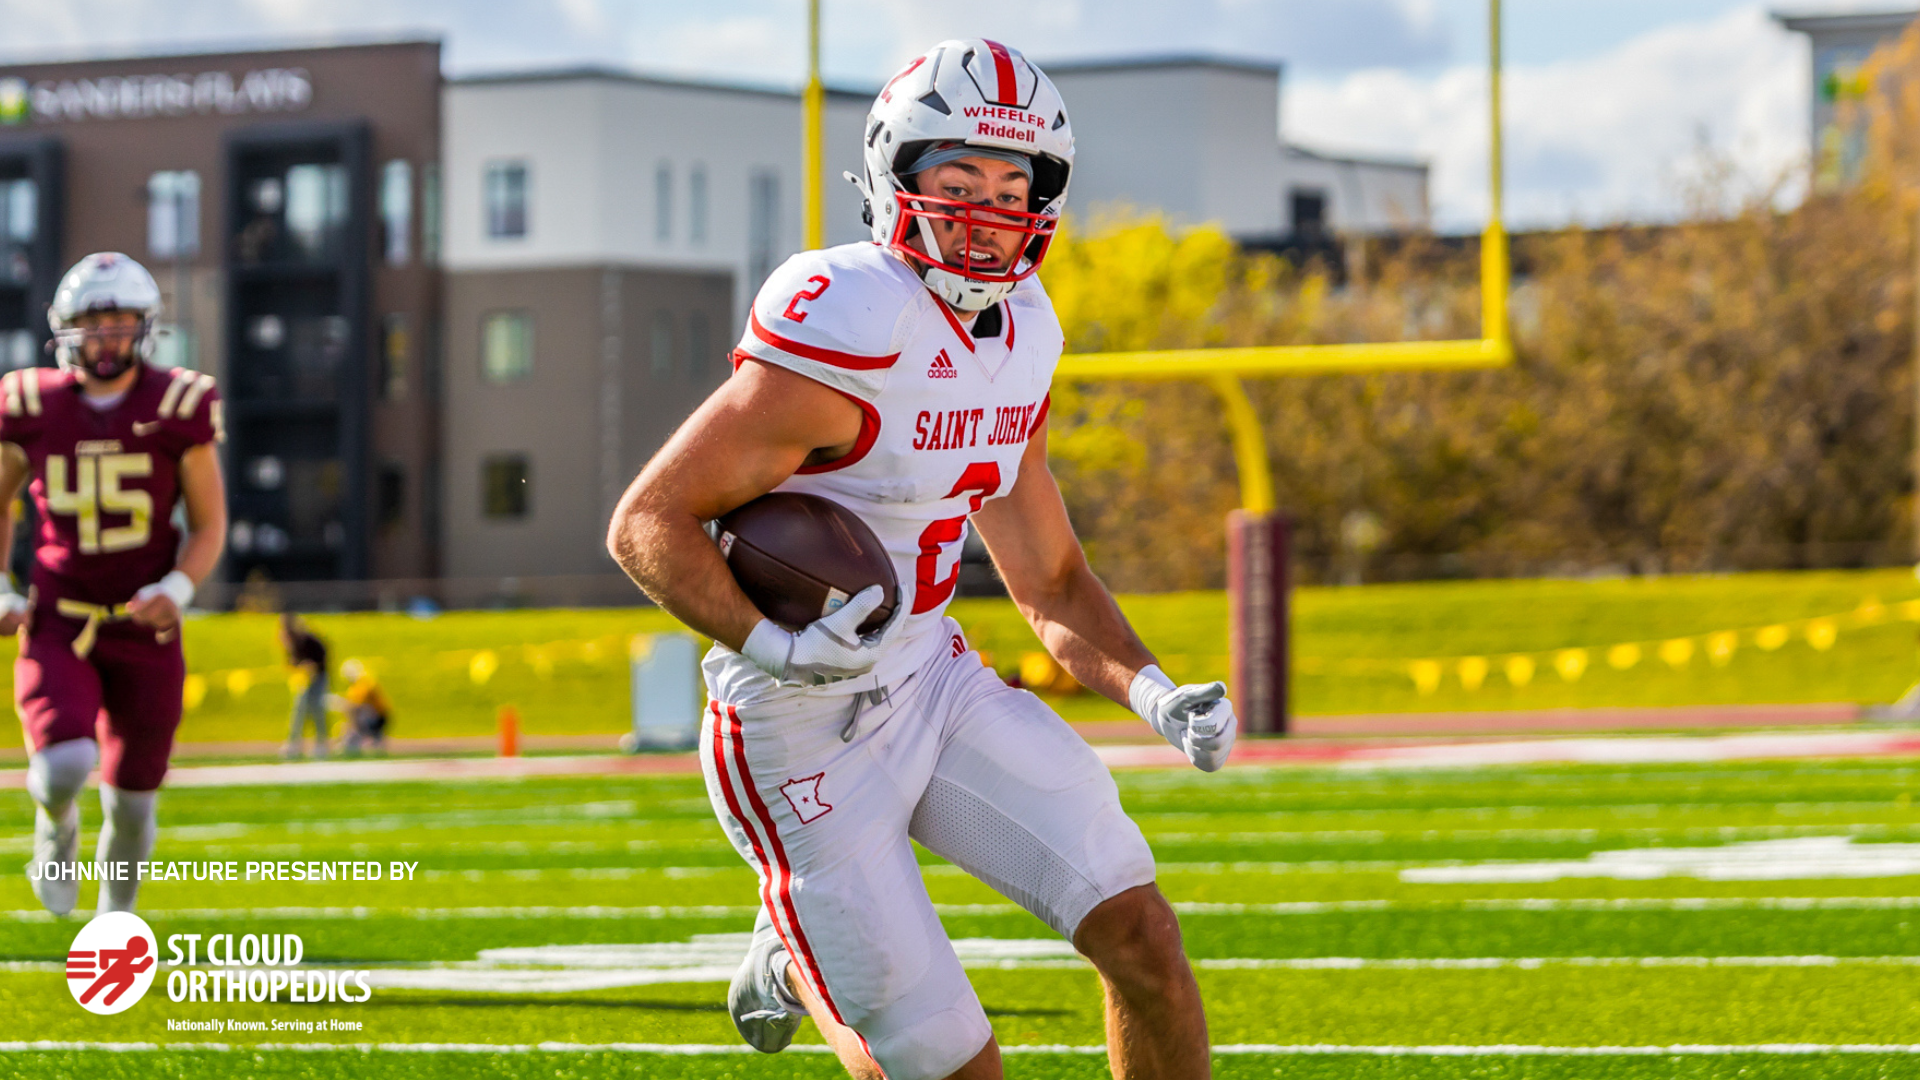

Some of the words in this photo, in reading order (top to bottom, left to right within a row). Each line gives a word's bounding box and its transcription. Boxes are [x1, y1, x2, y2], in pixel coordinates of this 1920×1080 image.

[963, 105, 1046, 130] WHEELER
[977, 121, 1036, 143] Riddell
[782, 274, 831, 324] 2
[927, 366, 958, 379] adidas
[912, 407, 985, 451] SAINT
[46, 452, 153, 553] 45
[909, 460, 1001, 615] 2
